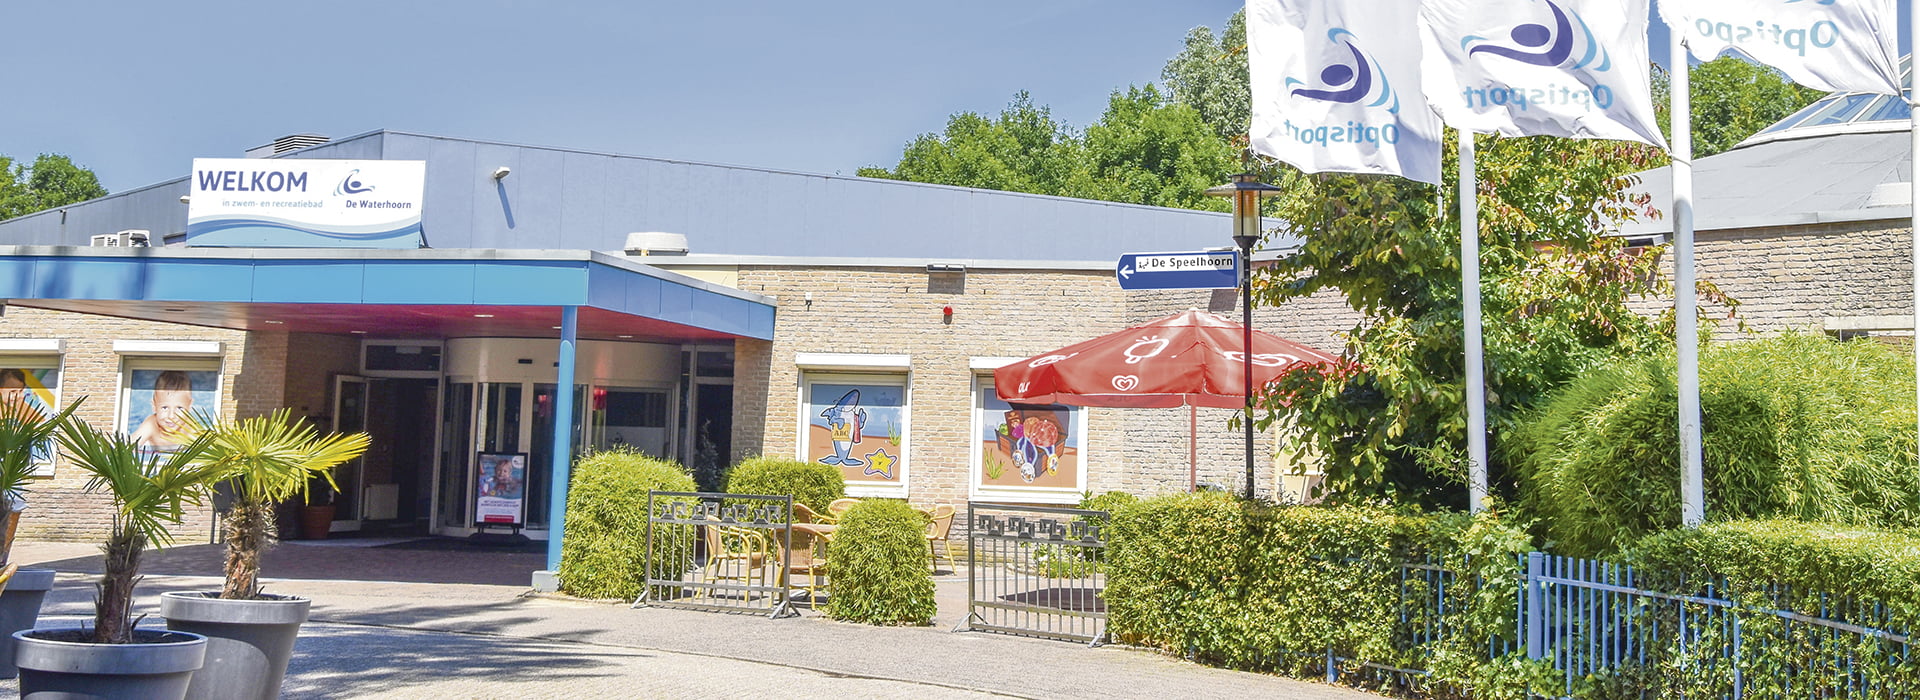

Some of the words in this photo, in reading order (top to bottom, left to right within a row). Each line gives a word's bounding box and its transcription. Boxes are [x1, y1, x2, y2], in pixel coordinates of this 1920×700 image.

[198, 170, 308, 193] WELKOM
[272, 200, 323, 208] recreatiebad
[346, 200, 357, 208] De
[359, 200, 412, 209] Waterhoorn
[1152, 258, 1165, 268] De
[1170, 257, 1233, 269] Speelhoorn
